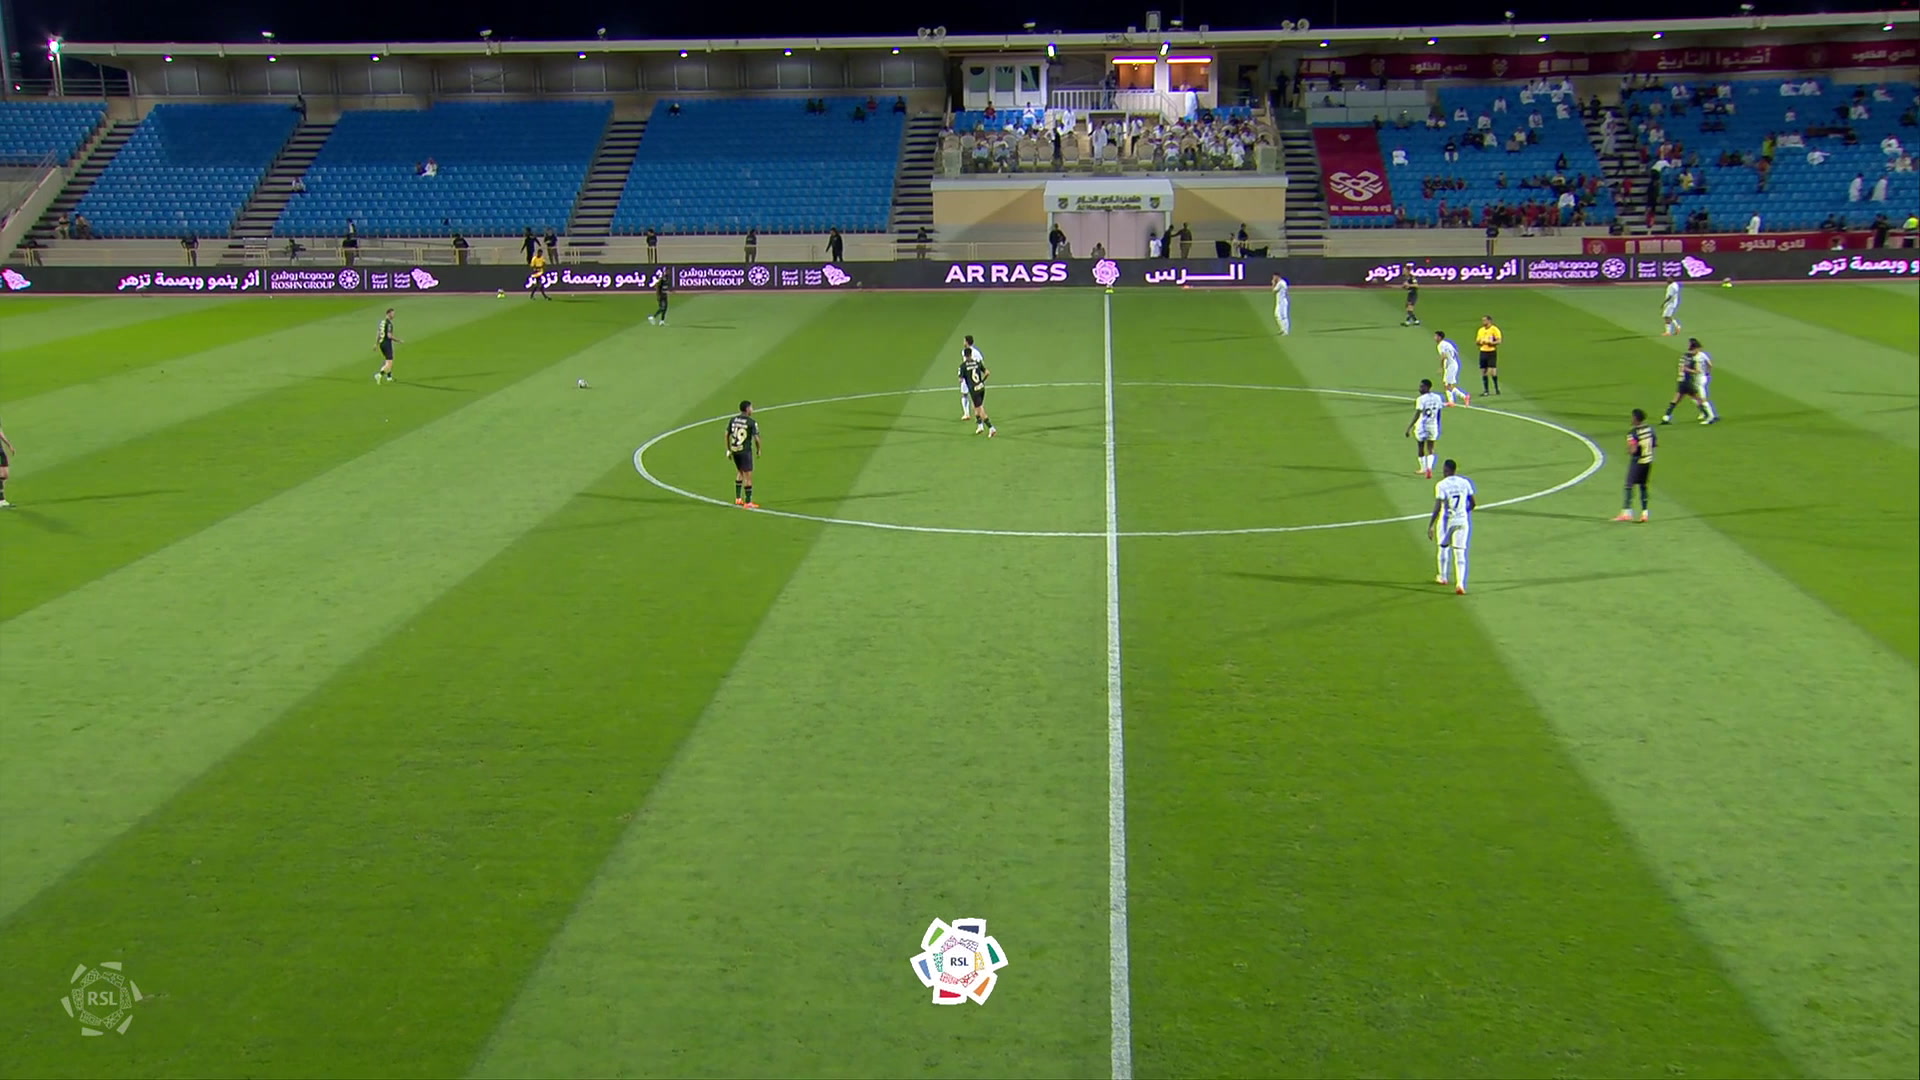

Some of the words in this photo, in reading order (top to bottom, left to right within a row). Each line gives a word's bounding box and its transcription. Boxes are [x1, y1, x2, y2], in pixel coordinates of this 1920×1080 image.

[945, 264, 985, 283] AR
[991, 263, 1068, 283] RASS
[1365, 264, 1400, 281] تزهر
[1460, 264, 1494, 281] ينمو
[1496, 258, 1517, 280] أثر
[1808, 258, 1847, 276] تزهر
[117, 273, 151, 290] تزهر
[154, 272, 204, 290] وبصمة
[207, 274, 238, 290] ينمو
[241, 269, 259, 290] أثر
[271, 281, 302, 289] ROSHN
[303, 281, 335, 289] GROUP
[562, 270, 611, 288] وبصمة
[615, 271, 646, 288] ينمو
[679, 278, 711, 287] ROSHN
[712, 278, 745, 287] GROUP
[972, 368, 980, 383] 6
[1452, 495, 1460, 508] 7
